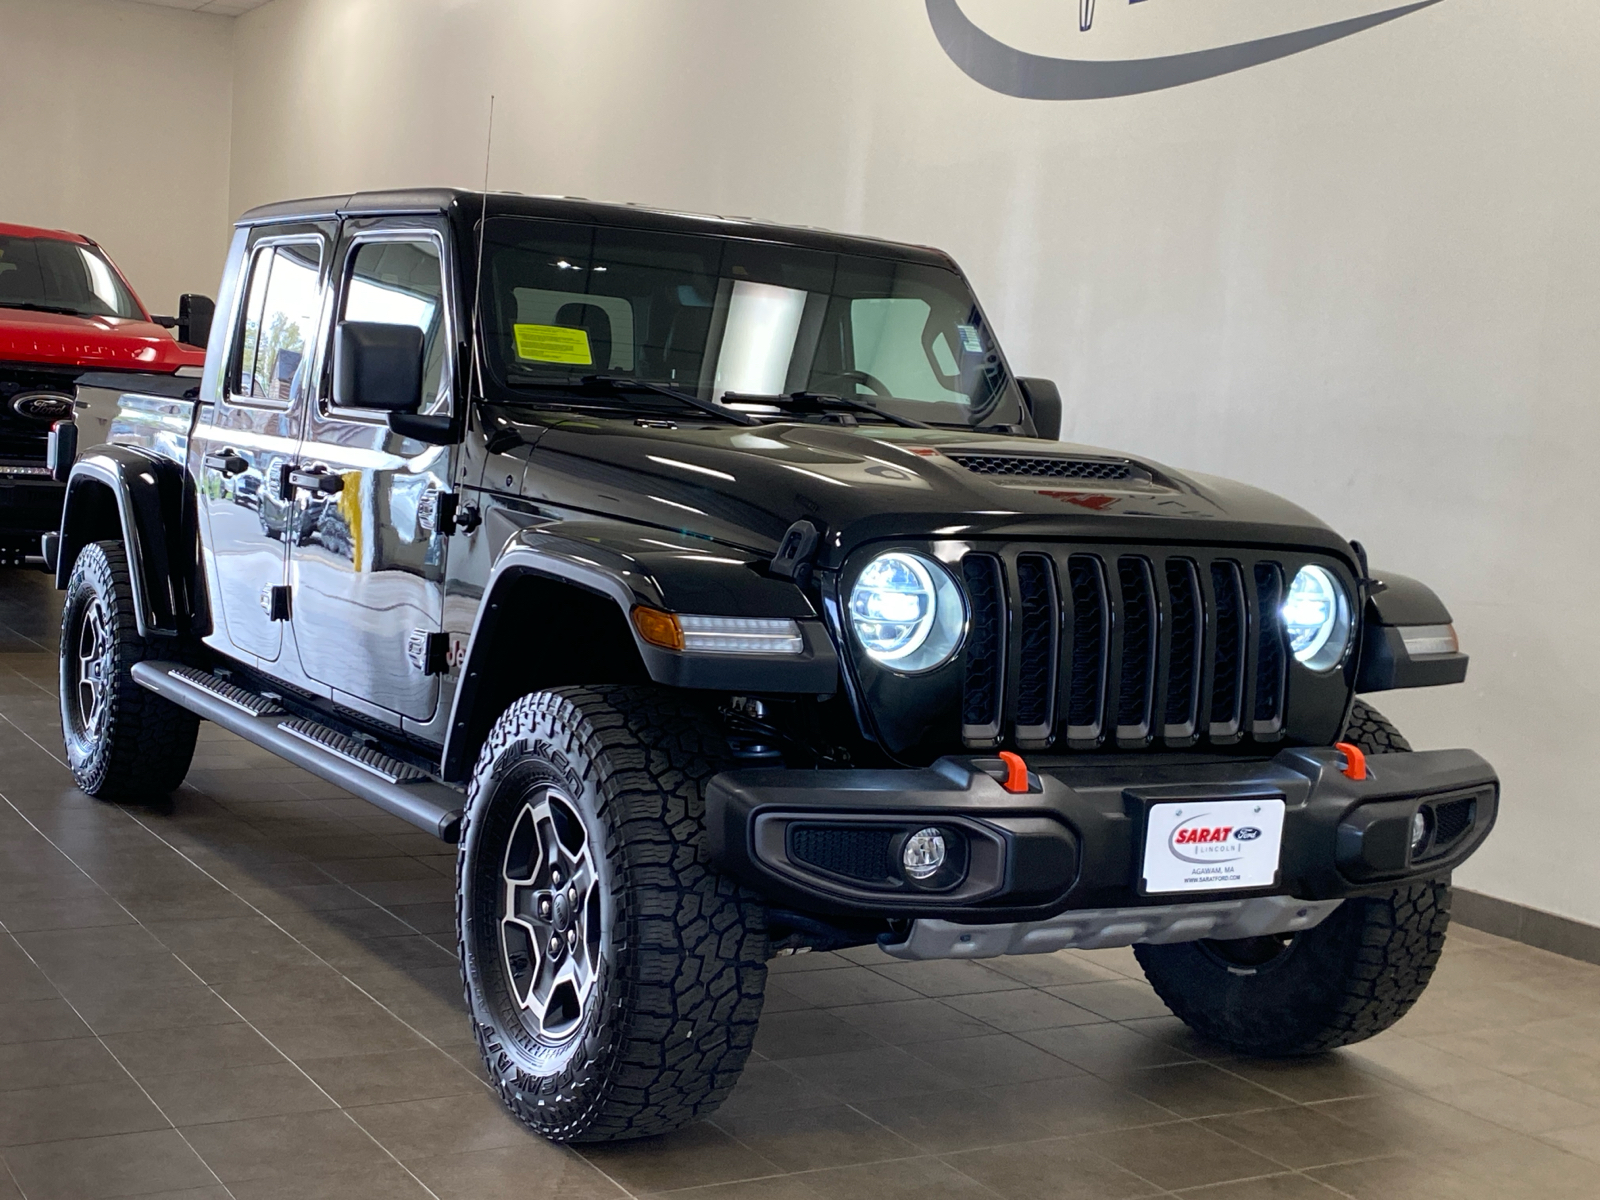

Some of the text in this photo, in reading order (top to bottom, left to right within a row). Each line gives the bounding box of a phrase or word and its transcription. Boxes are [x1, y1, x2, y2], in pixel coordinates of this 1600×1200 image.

[30, 399, 66, 415] Ford
[446, 640, 466, 668] Je
[1175, 826, 1259, 844] SARAT Ford
[1200, 845, 1236, 853] LINCOLN
[1192, 867, 1223, 875] AGAWAM,
